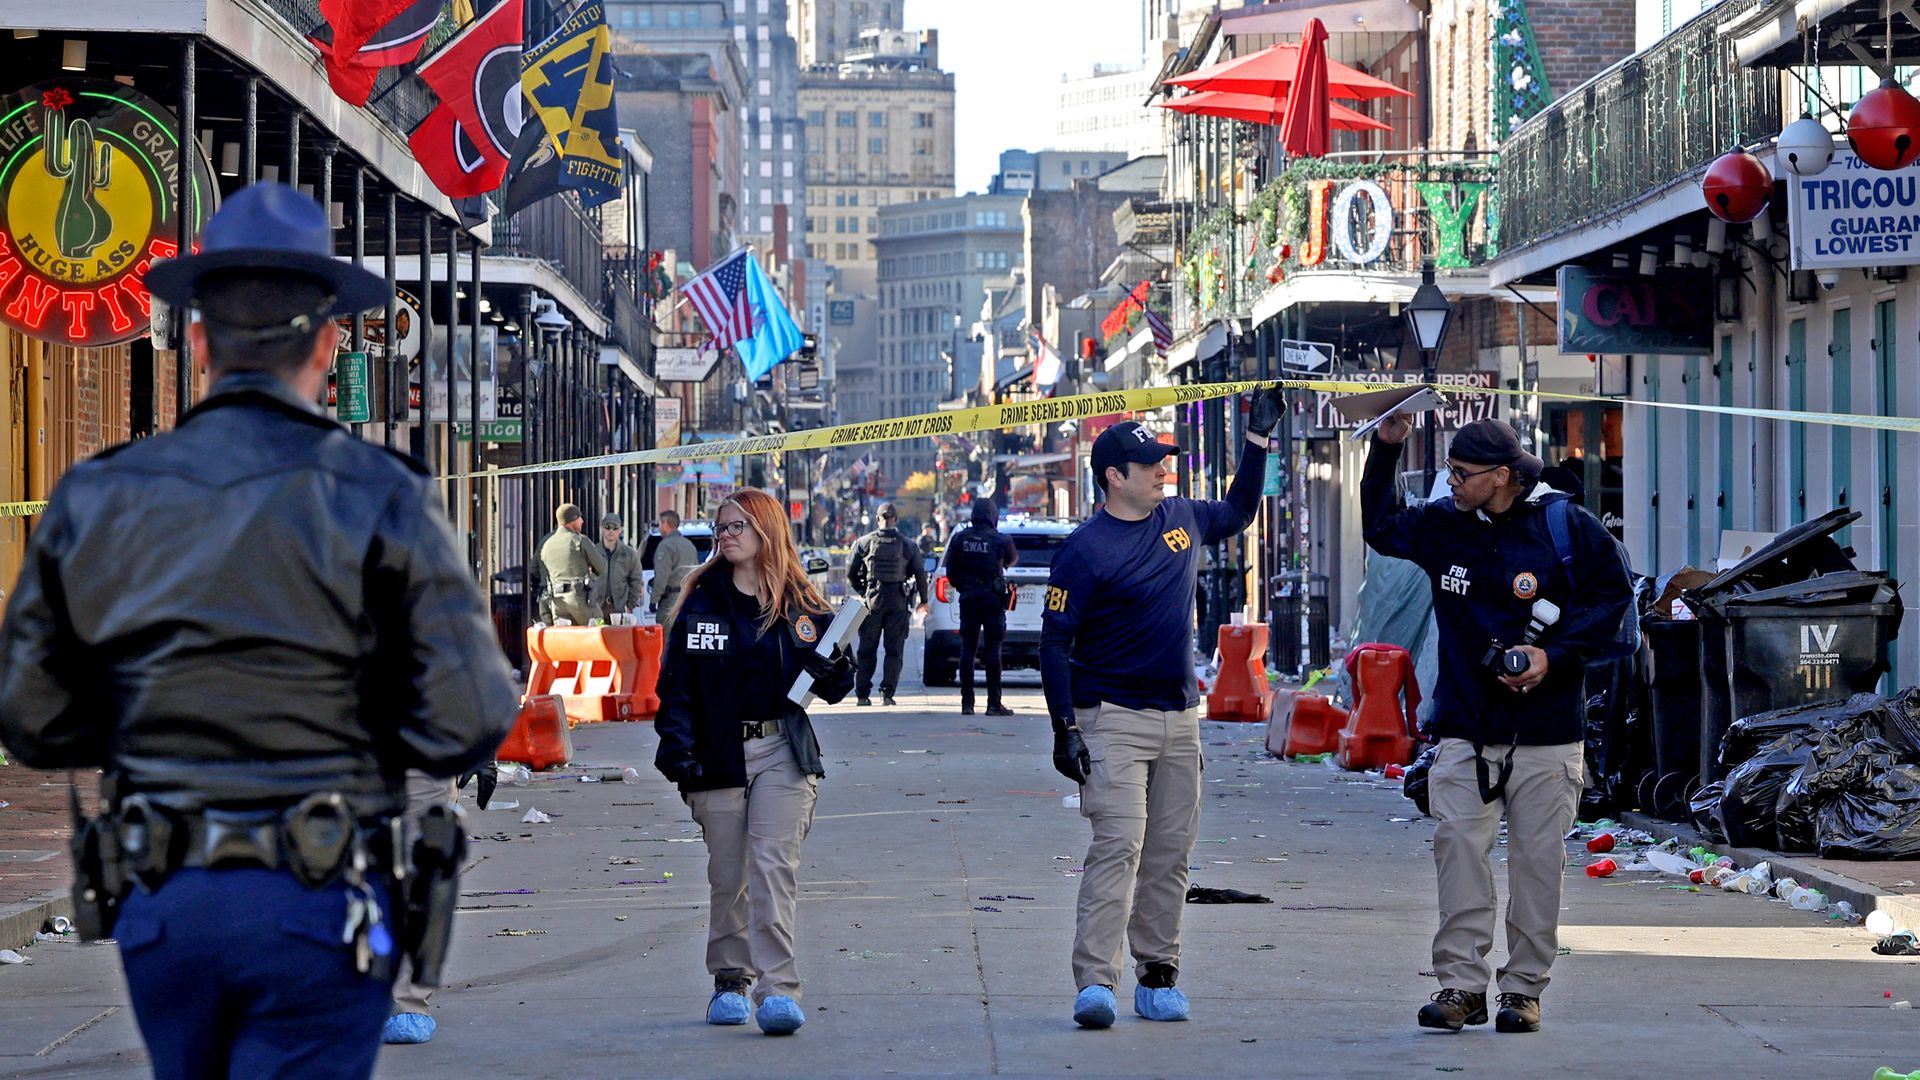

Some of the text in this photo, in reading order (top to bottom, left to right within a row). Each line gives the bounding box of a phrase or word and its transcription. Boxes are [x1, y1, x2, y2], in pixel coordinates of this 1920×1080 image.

[1, 112, 39, 152] LIFE
[1802, 176, 1916, 210] TRICOU
[1300, 179, 1487, 268] JOY
[18, 232, 136, 280] HUGE ASS
[1815, 235, 1912, 255] LOWEST
[1322, 373, 1393, 384] MAISON
[1000, 394, 1126, 425] CRIME SCENE DO NOT CROSS
[830, 415, 953, 443] CRIME SCENE DO NOT CROSS
[667, 436, 787, 459] CRIME SCENE DO NOT CROSS
[963, 541, 989, 553] SWAT
[1162, 527, 1191, 553] FBI
[1449, 565, 1467, 579] FBI
[1441, 574, 1470, 596] ERT
[697, 622, 719, 634] FBI
[1800, 624, 1838, 653] IV
[687, 633, 728, 651] ERT
